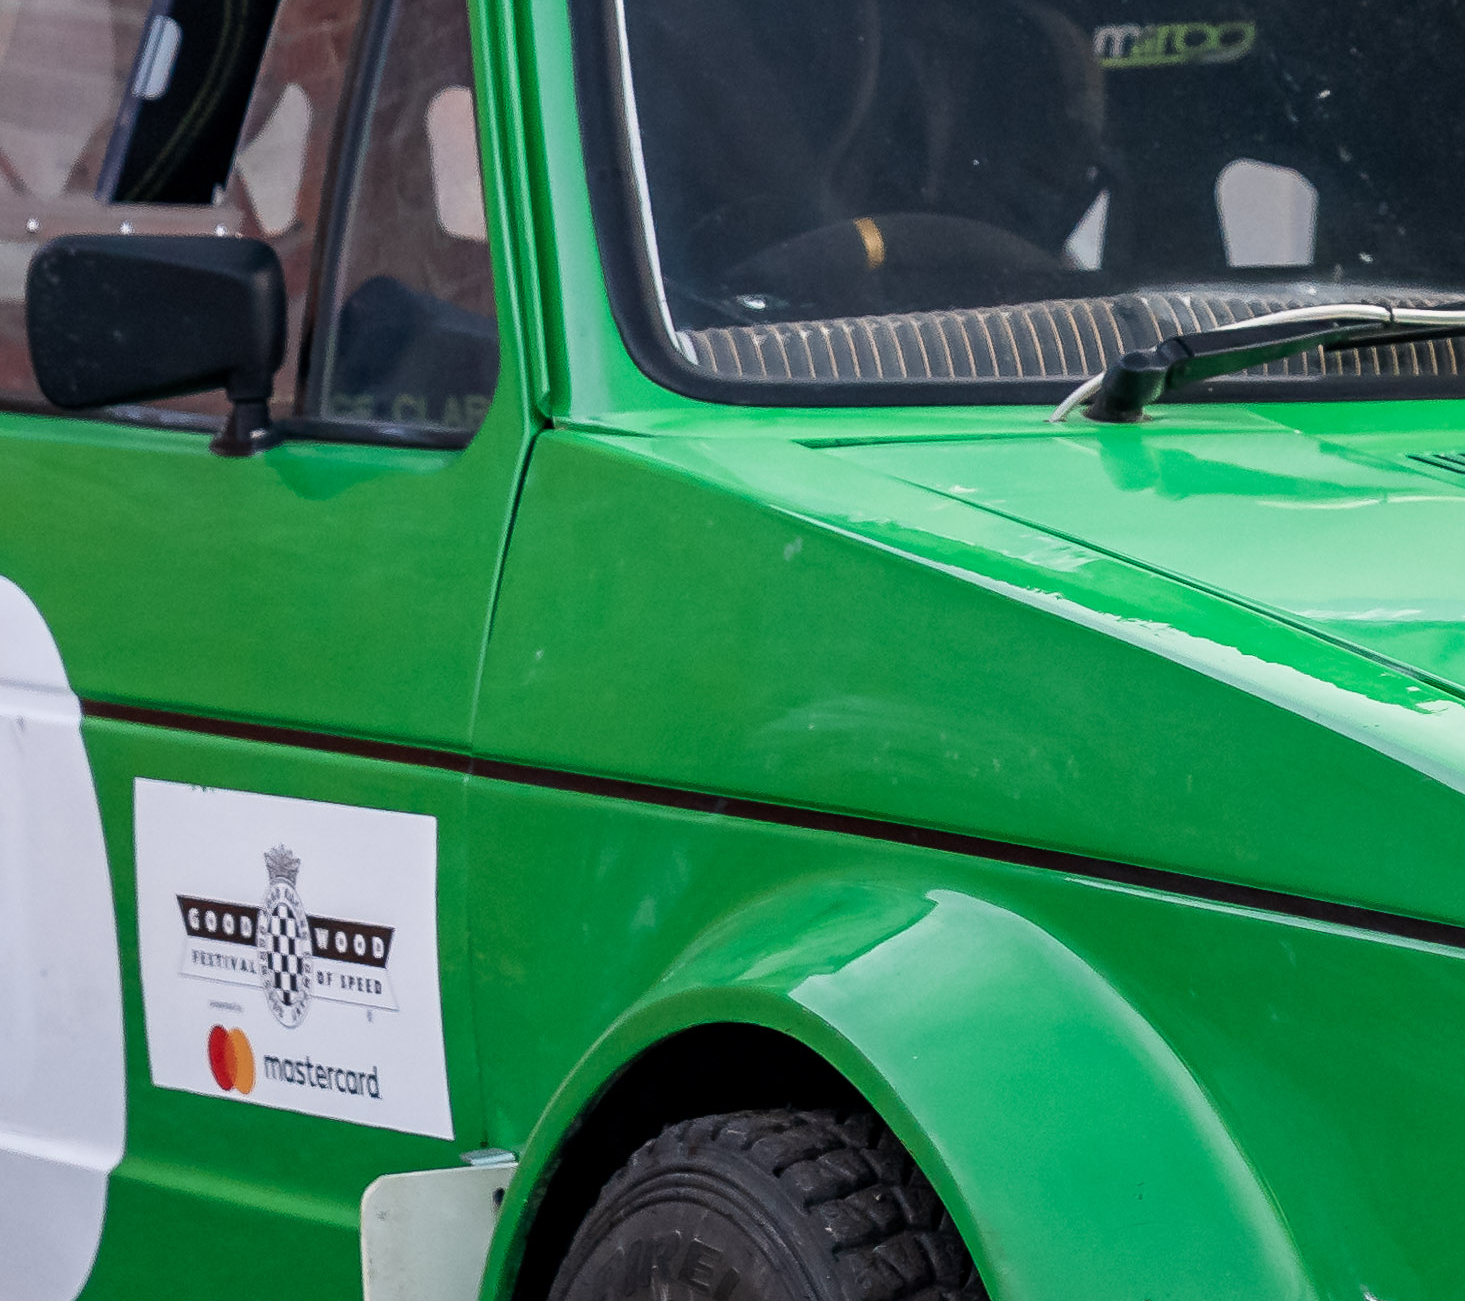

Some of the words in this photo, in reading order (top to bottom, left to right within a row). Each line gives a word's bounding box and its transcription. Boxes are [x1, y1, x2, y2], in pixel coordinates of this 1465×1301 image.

[187, 905, 254, 940] GOOD
[313, 926, 386, 960] WOOD
[191, 948, 258, 975] FESTIVAL
[316, 970, 333, 987] OF
[339, 974, 383, 996] SPEED
[263, 1053, 382, 1100] mastercard
